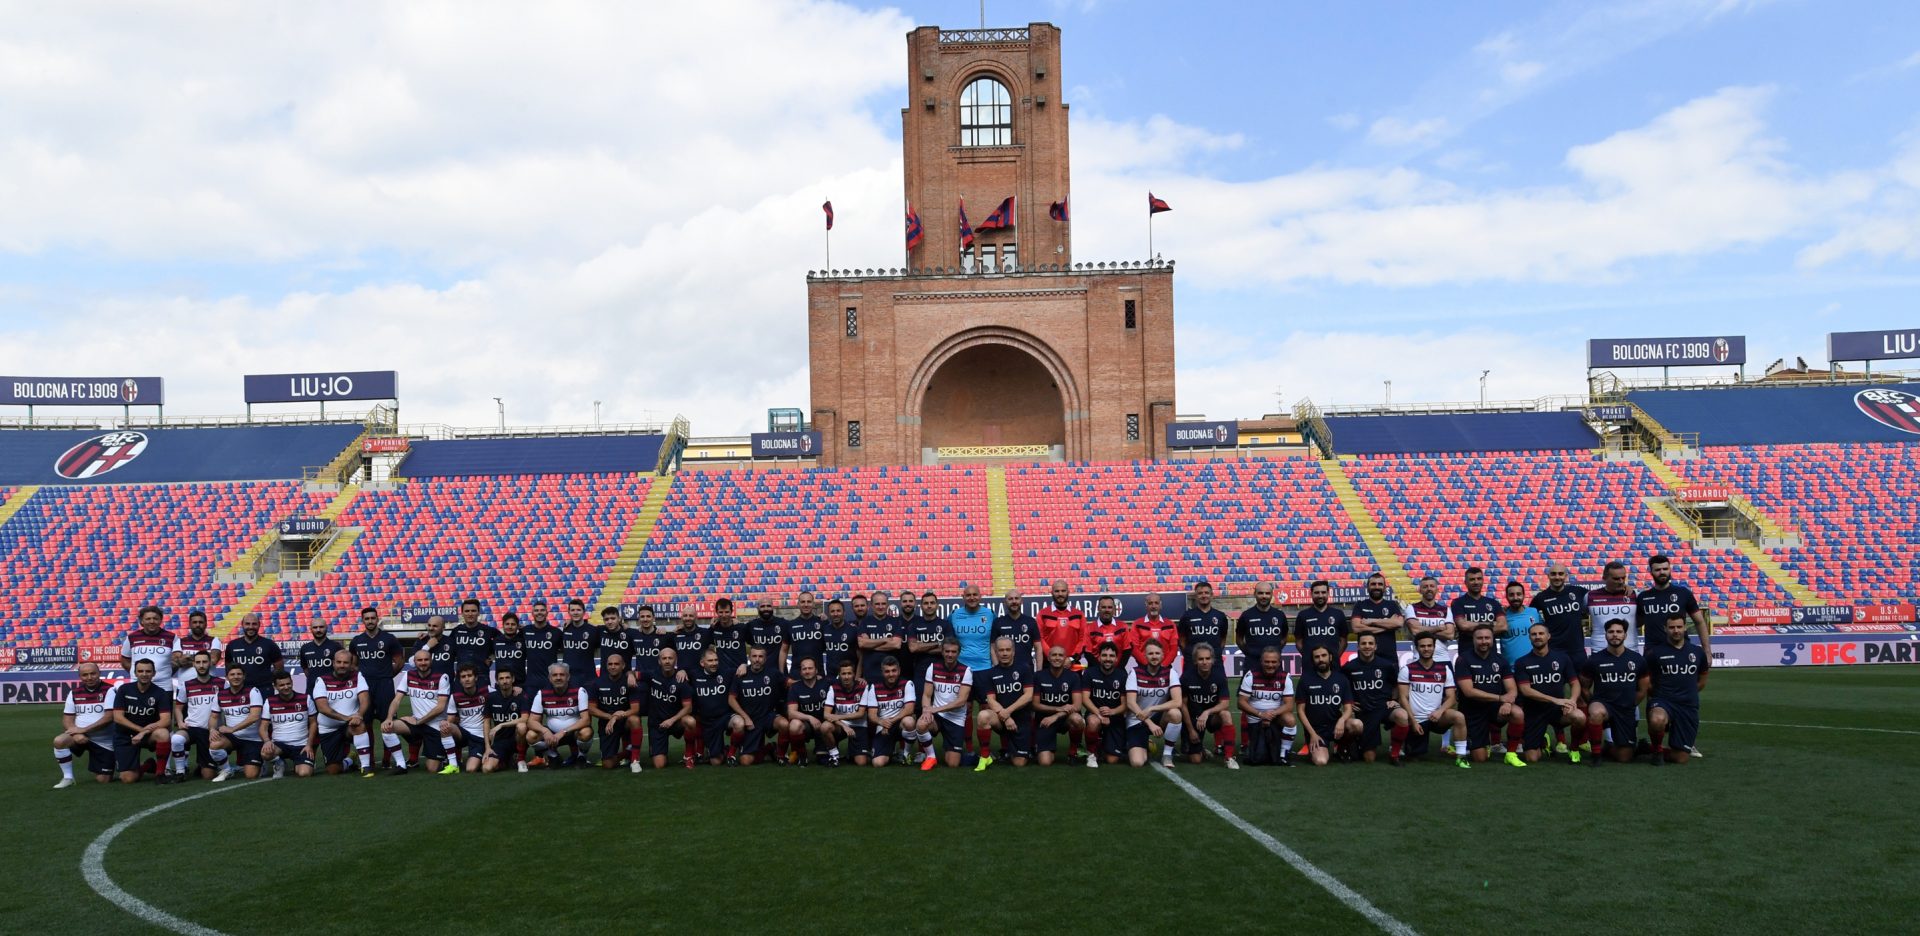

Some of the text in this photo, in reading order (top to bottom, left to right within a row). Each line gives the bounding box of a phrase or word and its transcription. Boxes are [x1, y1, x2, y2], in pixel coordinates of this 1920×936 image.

[1612, 342, 1710, 360] BOLOGNA FC 1909
[13, 382, 118, 399] BOLOGNA FC 1909
[1862, 390, 1905, 401] BFC
[101, 432, 140, 443] BFC
[1176, 429, 1208, 440] BOLOGNA
[761, 439, 791, 449] BOLOGNA
[1688, 489, 1727, 498] SOLAROLO
[296, 521, 325, 530] BUDRIO
[1329, 587, 1361, 596] OLOGNA
[413, 607, 457, 616] GRAPPA KORPS
[1806, 607, 1850, 616] CALDERARA
[31, 647, 75, 656] ARPAD WEISZ
[93, 646, 103, 655] THE
[1811, 642, 1857, 665] BFC
[1722, 658, 1740, 666] CUP
[3, 681, 80, 703] PARTN
